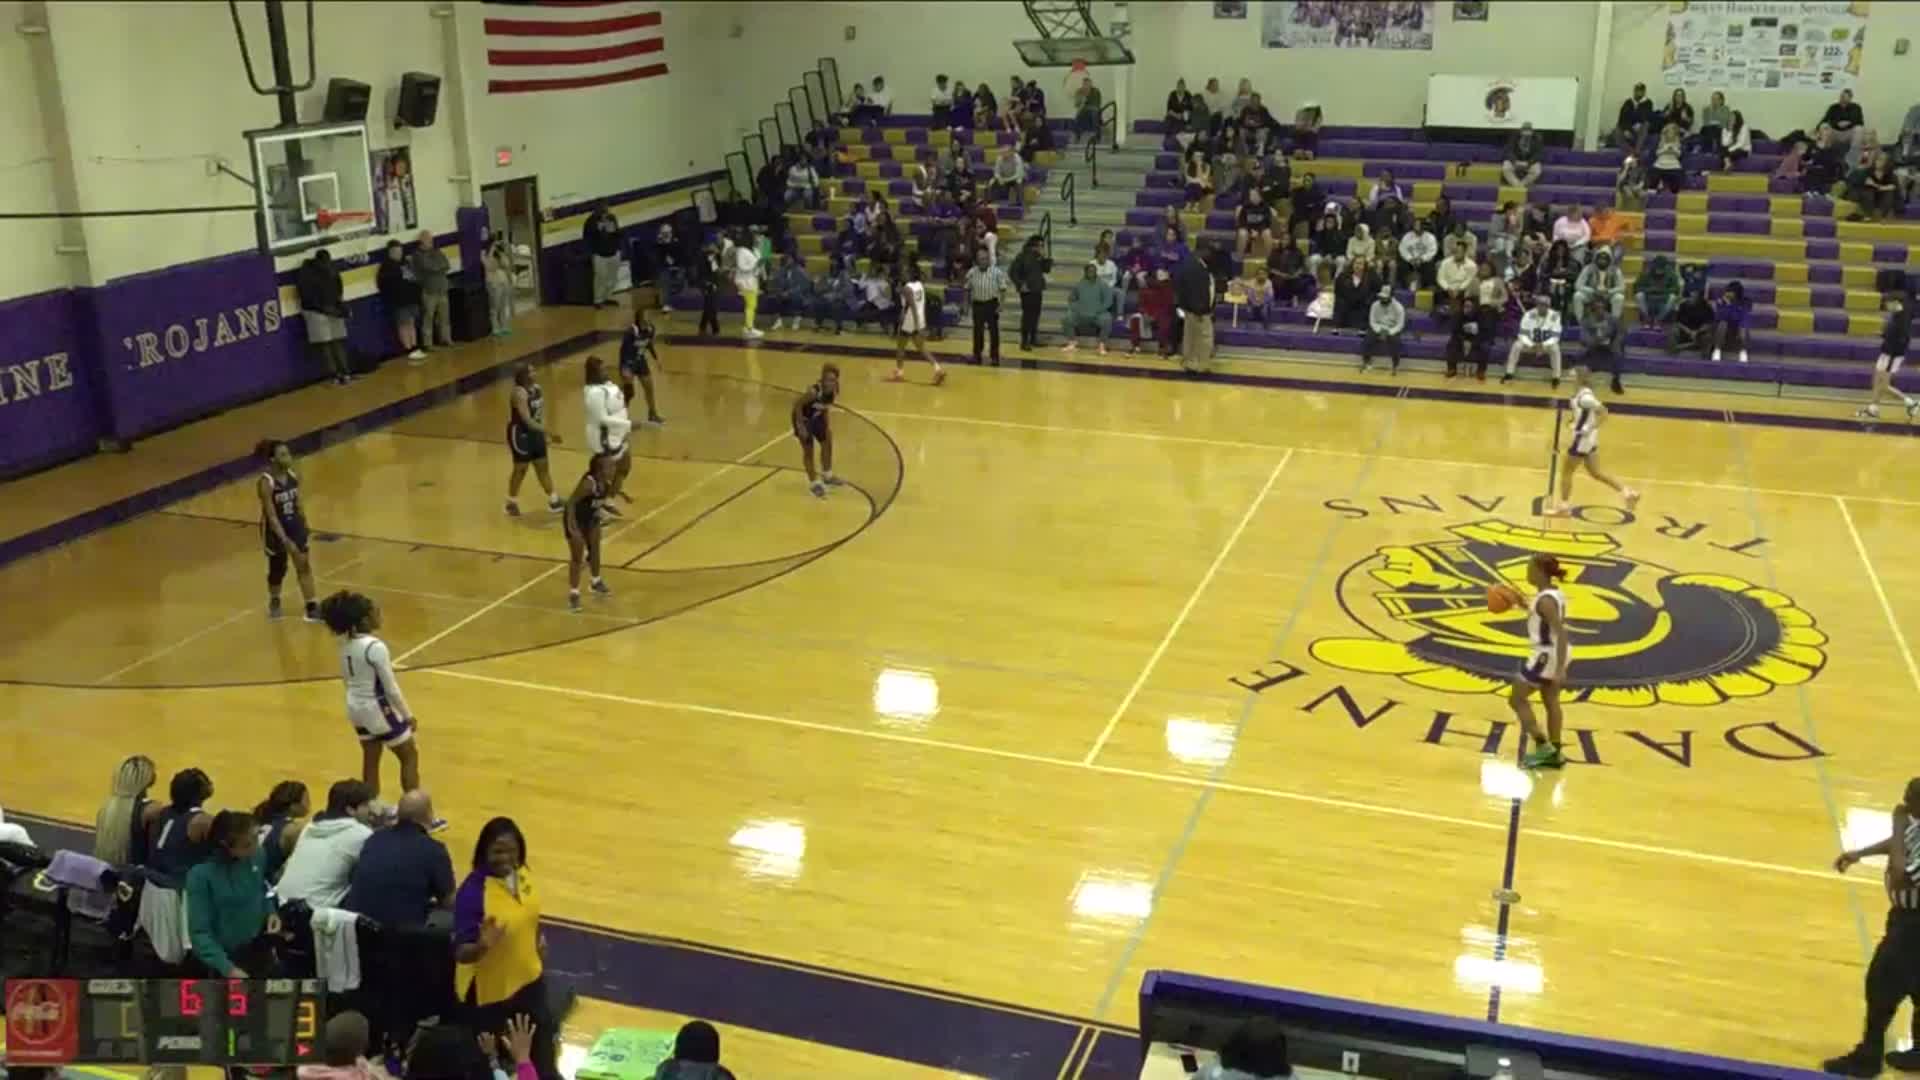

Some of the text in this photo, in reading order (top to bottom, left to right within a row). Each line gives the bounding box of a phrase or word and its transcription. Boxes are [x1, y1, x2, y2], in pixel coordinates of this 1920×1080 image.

[123, 300, 281, 370] ROJANS
[346, 655, 355, 677] 1
[157, 819, 175, 849] 1
